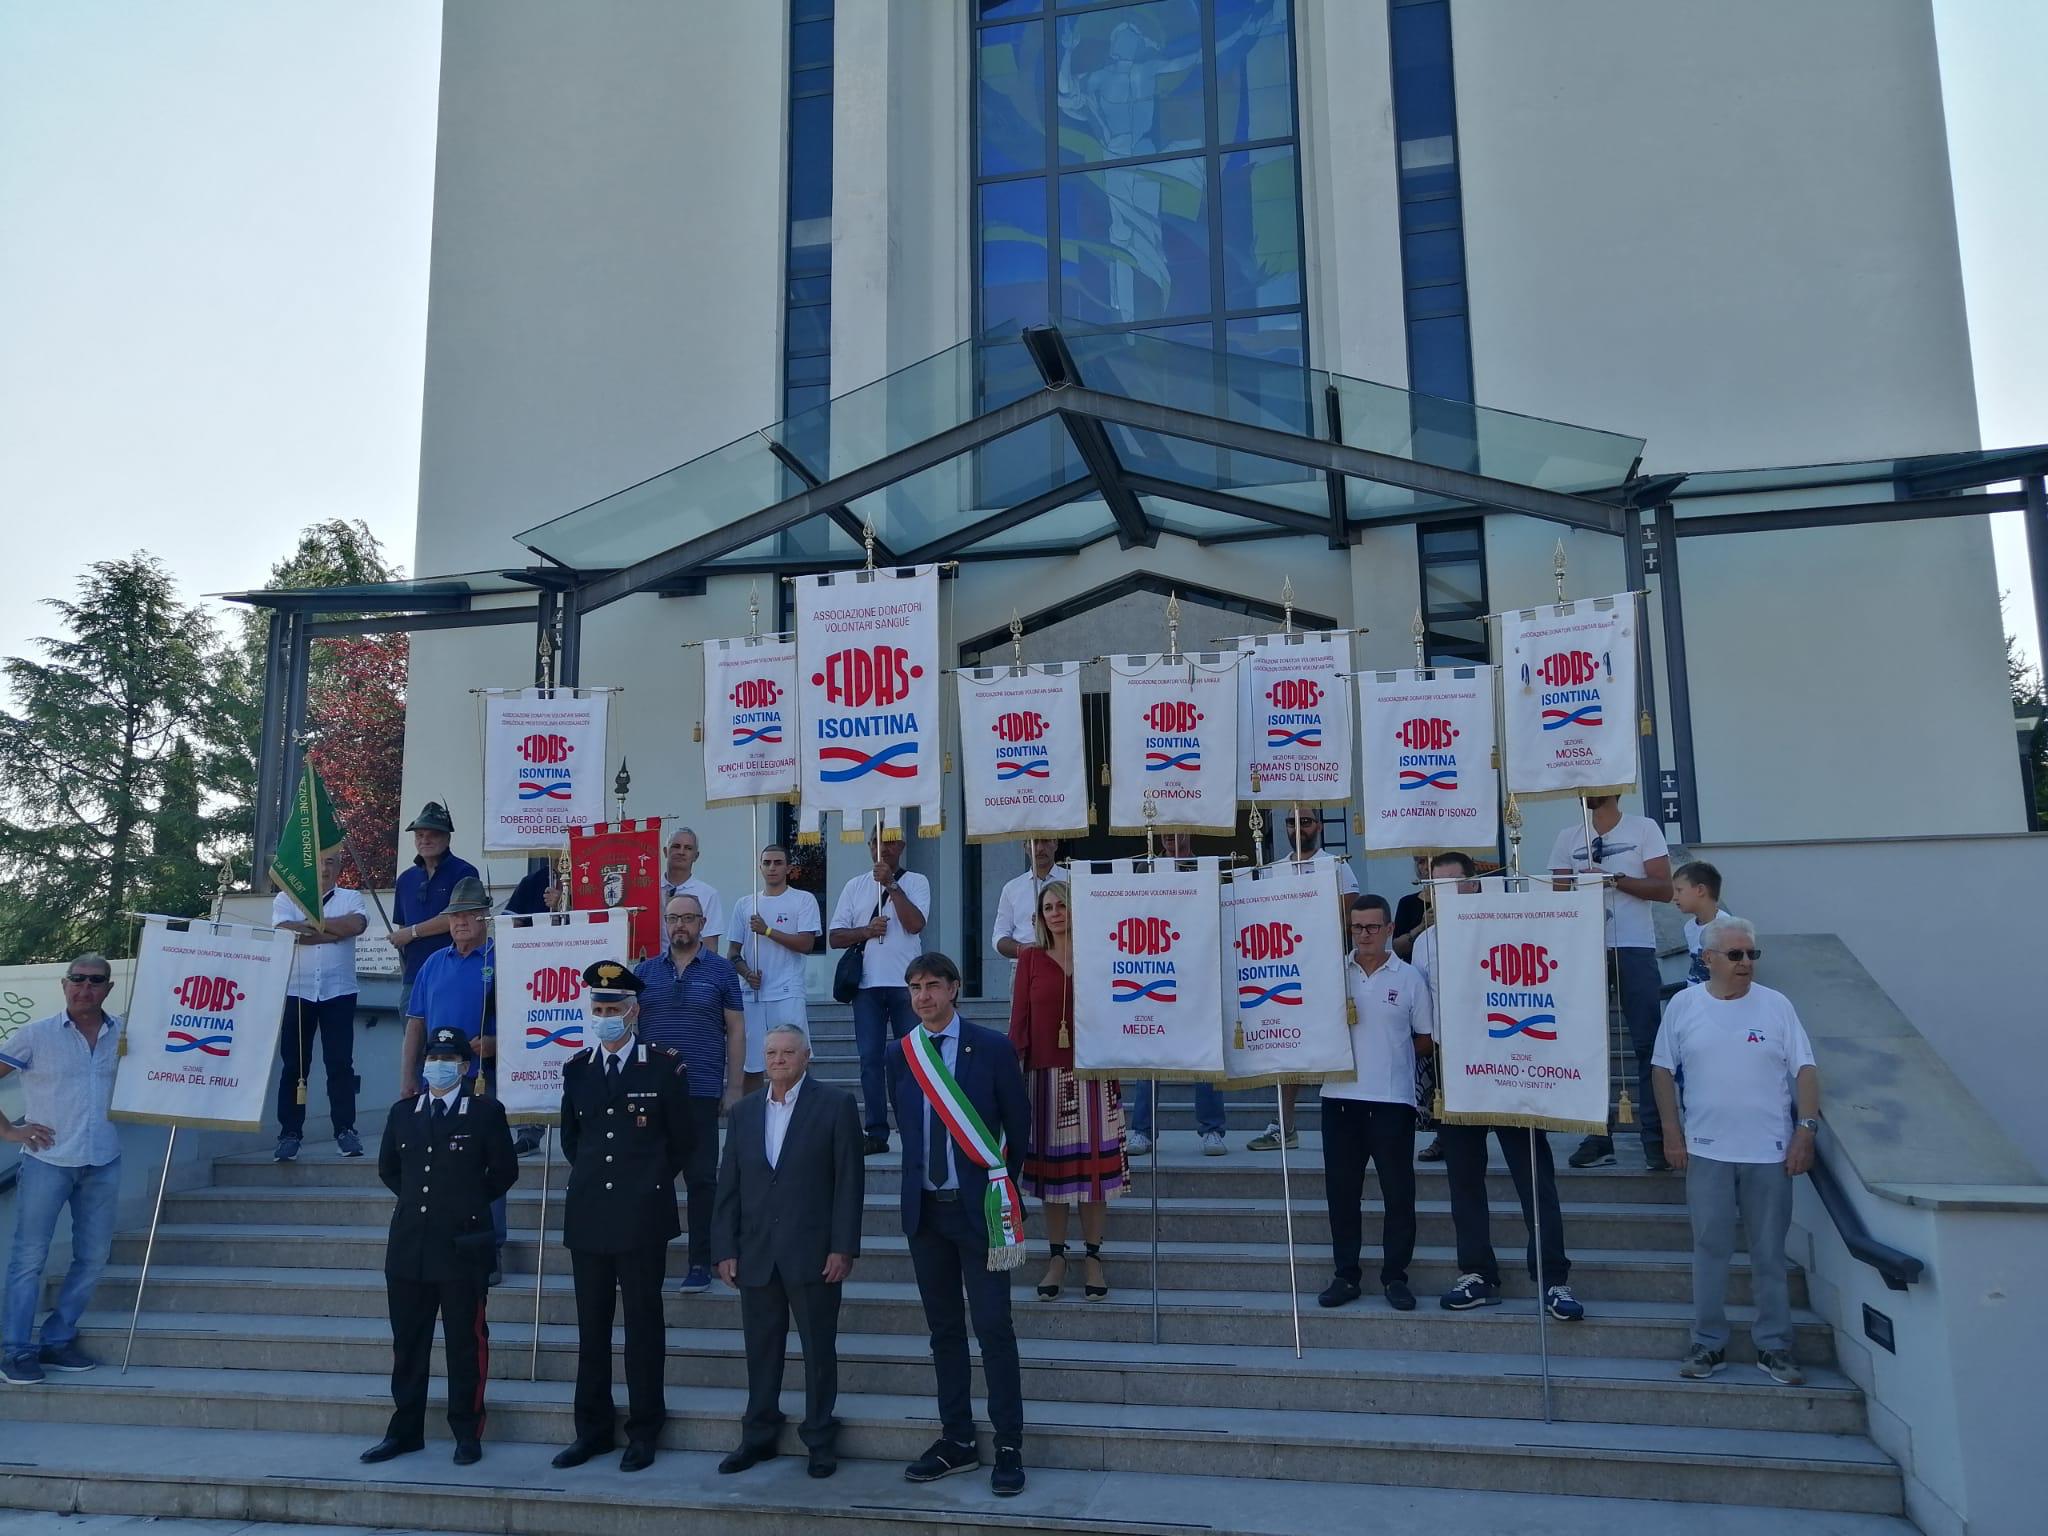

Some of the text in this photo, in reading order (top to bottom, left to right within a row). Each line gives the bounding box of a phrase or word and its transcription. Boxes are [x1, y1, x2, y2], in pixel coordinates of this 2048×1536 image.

[814, 602, 922, 621] ASSOCIAZIONE DONATORI
[824, 617, 910, 632] VOLONTARI SANGUE
[826, 645, 909, 707] FIDAS
[1544, 651, 1593, 687] FIDAS
[736, 679, 776, 708] FIDAS
[1273, 679, 1318, 709] FIDAS
[1542, 689, 1600, 706] ISONTINA
[733, 712, 781, 725] ISONTINA
[1151, 702, 1196, 732] FIDAS
[1268, 714, 1321, 725] ISONTINA
[818, 713, 918, 738] ISONTINA
[999, 711, 1042, 742] FIDAS
[1403, 718, 1451, 750] FIDAS
[524, 734, 567, 763] FIDAS
[1147, 738, 1200, 748] ISONTINA
[996, 746, 1047, 758] ISONTINA
[1556, 748, 1592, 758] MOSSA
[718, 762, 743, 773] RONCHI
[746, 761, 758, 769] DEI
[1295, 762, 1338, 771] D'ISONZO
[1400, 755, 1456, 766] ISONTINA
[520, 768, 570, 778] ISONTINA
[1290, 773, 1305, 781] DAL
[985, 794, 1064, 806] DOLEGNA DEL COLLIO
[501, 813, 542, 823] DOBERDÒ
[1382, 808, 1476, 818] SAN CANZIAN D'ISONZO
[301, 818, 309, 826] DI
[302, 830, 312, 868] GORIZIA
[1118, 917, 1170, 955] FIDAS
[1241, 922, 1292, 960] FIDAS
[1113, 961, 1175, 974] ISONTINA
[1239, 964, 1299, 981] ISONTINA
[1490, 943, 1549, 986] FIDAS
[533, 967, 580, 1003] FIDAS
[180, 976, 238, 1011] FIDAS
[1487, 992, 1554, 1008] ISONTINA
[171, 1014, 234, 1031] ISONTINA
[528, 1009, 583, 1022] ISONTINA
[1123, 1025, 1165, 1035] MEDEA
[1246, 1028, 1301, 1041] LUCINICO
[148, 1071, 238, 1087] CAPRIVA DEL FRIULI
[512, 1071, 541, 1081] GRADISCA
[1466, 1064, 1519, 1076] MARIANO
[1528, 1066, 1581, 1080] CORONA
